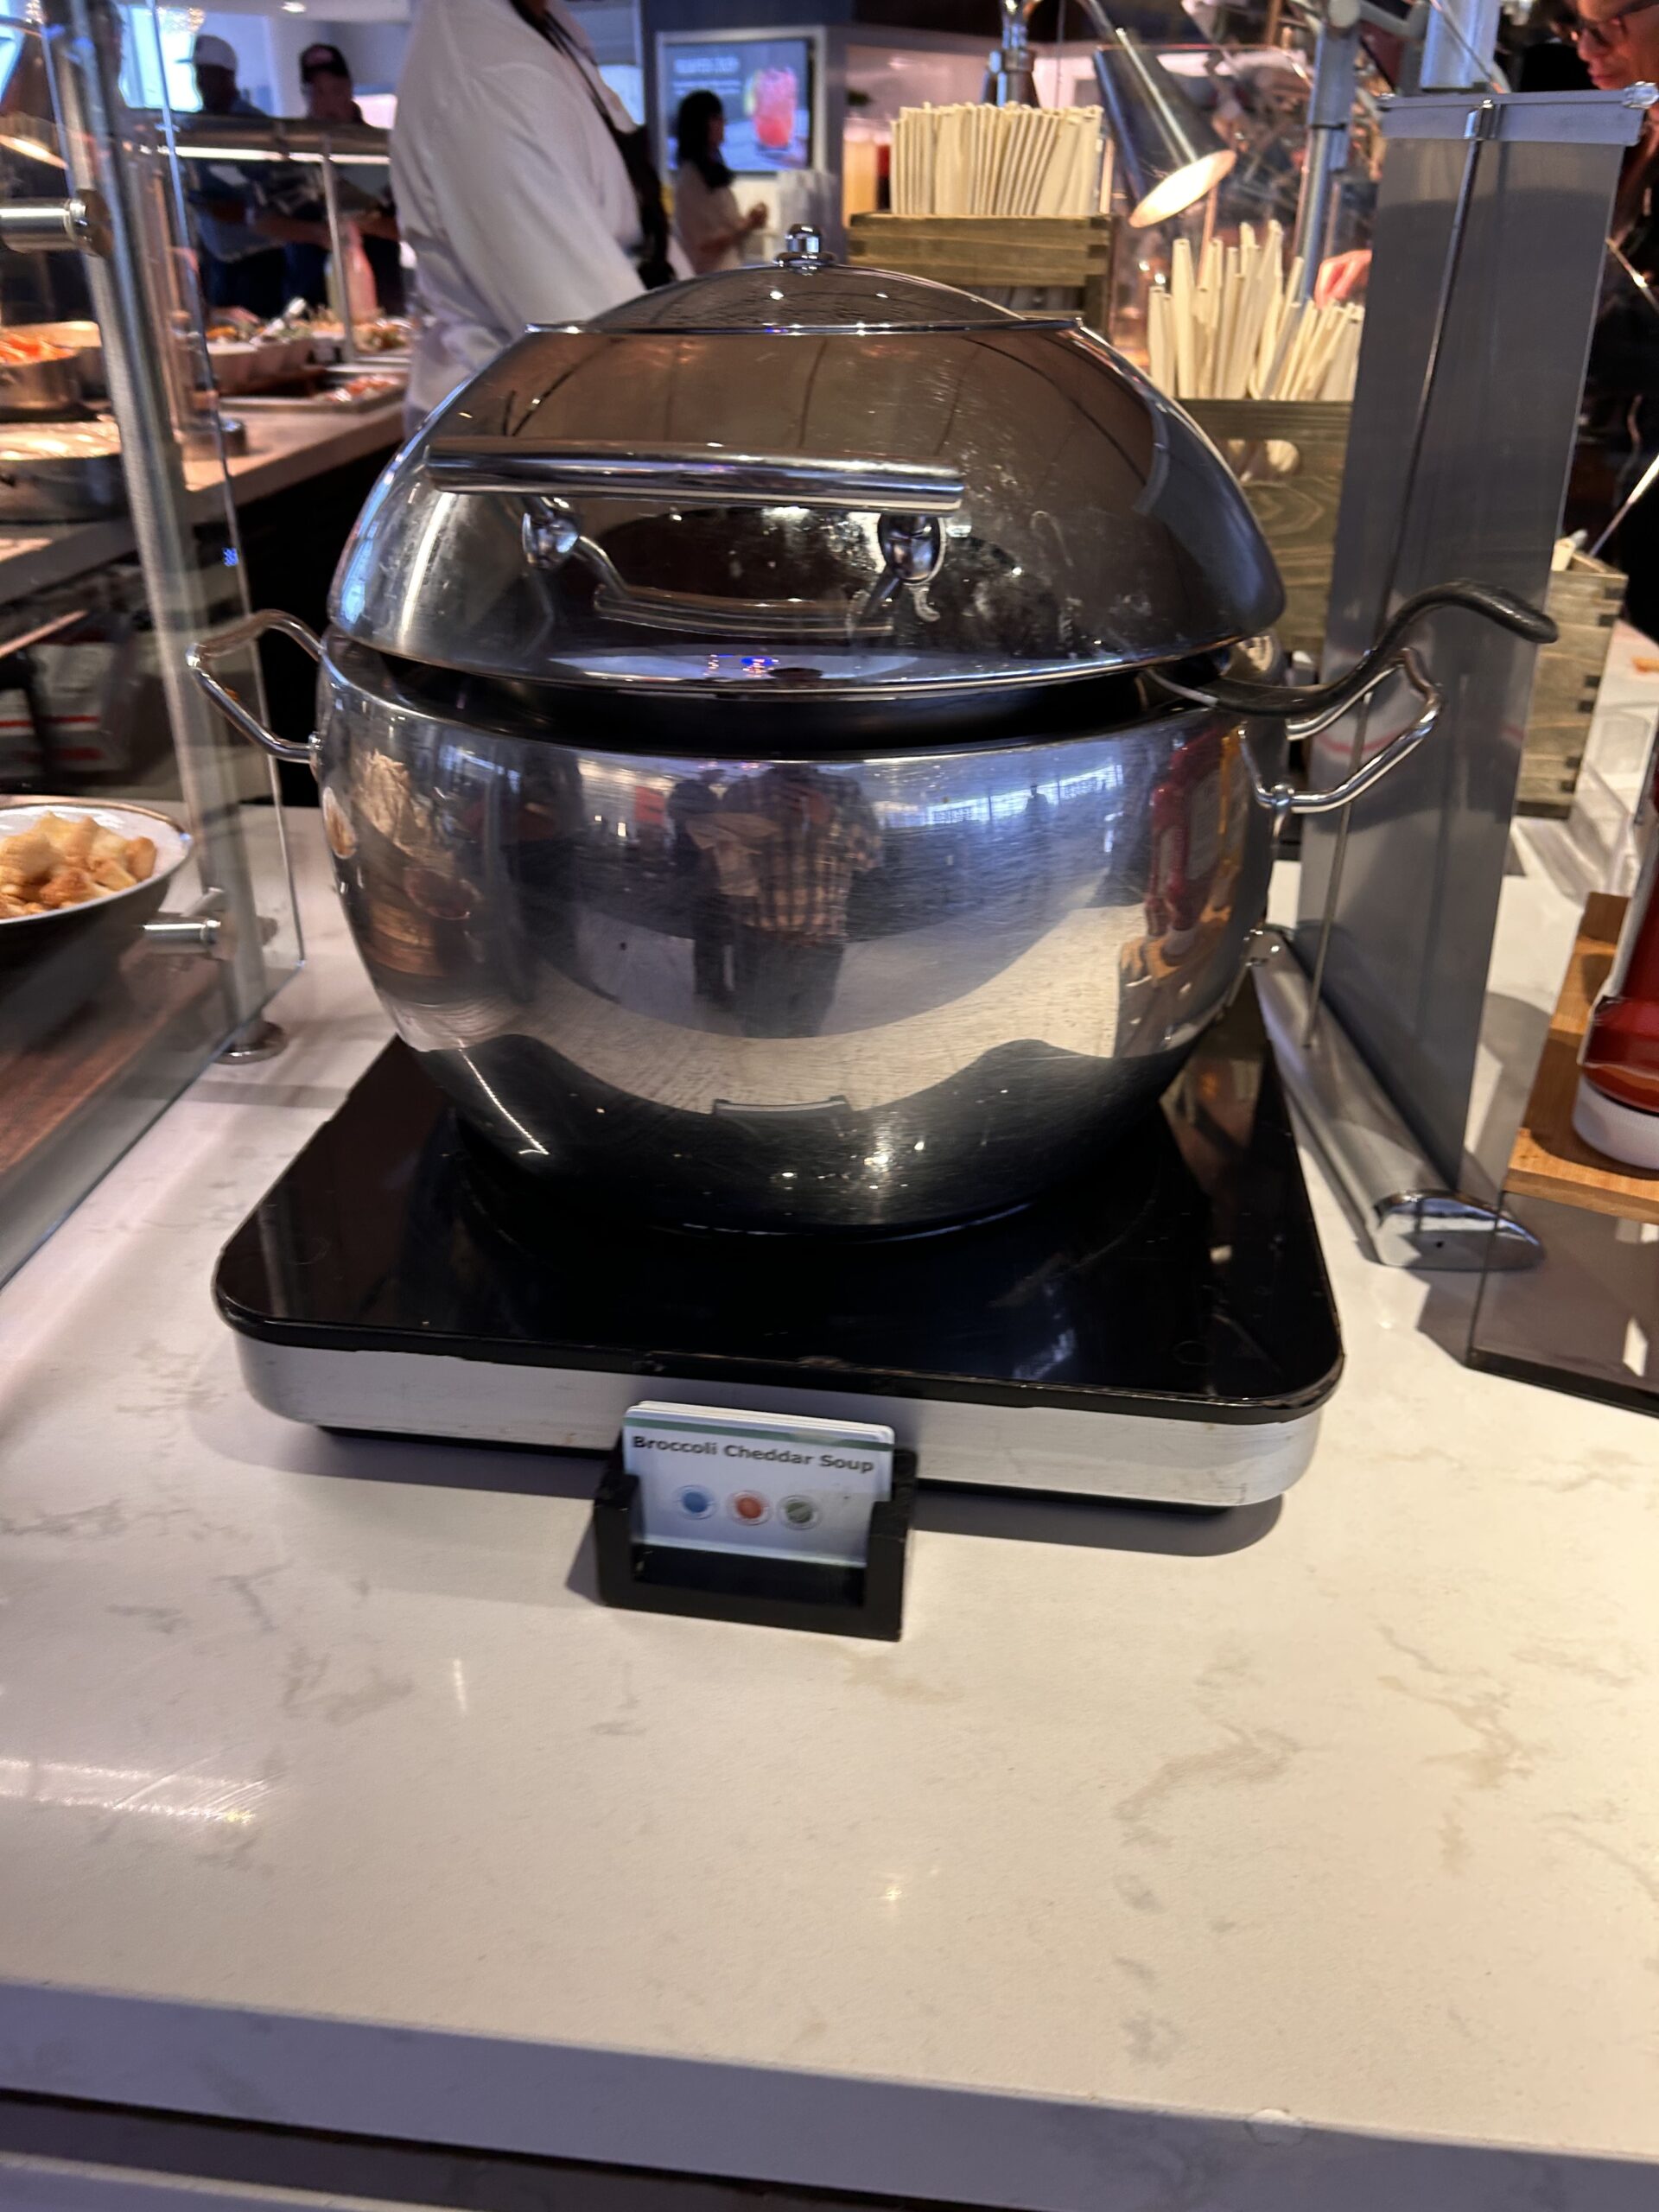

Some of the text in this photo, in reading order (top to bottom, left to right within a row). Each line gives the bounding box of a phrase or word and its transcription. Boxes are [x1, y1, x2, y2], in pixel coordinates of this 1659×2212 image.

[632, 1435, 874, 1473] Broccoli Cheddar Soup
